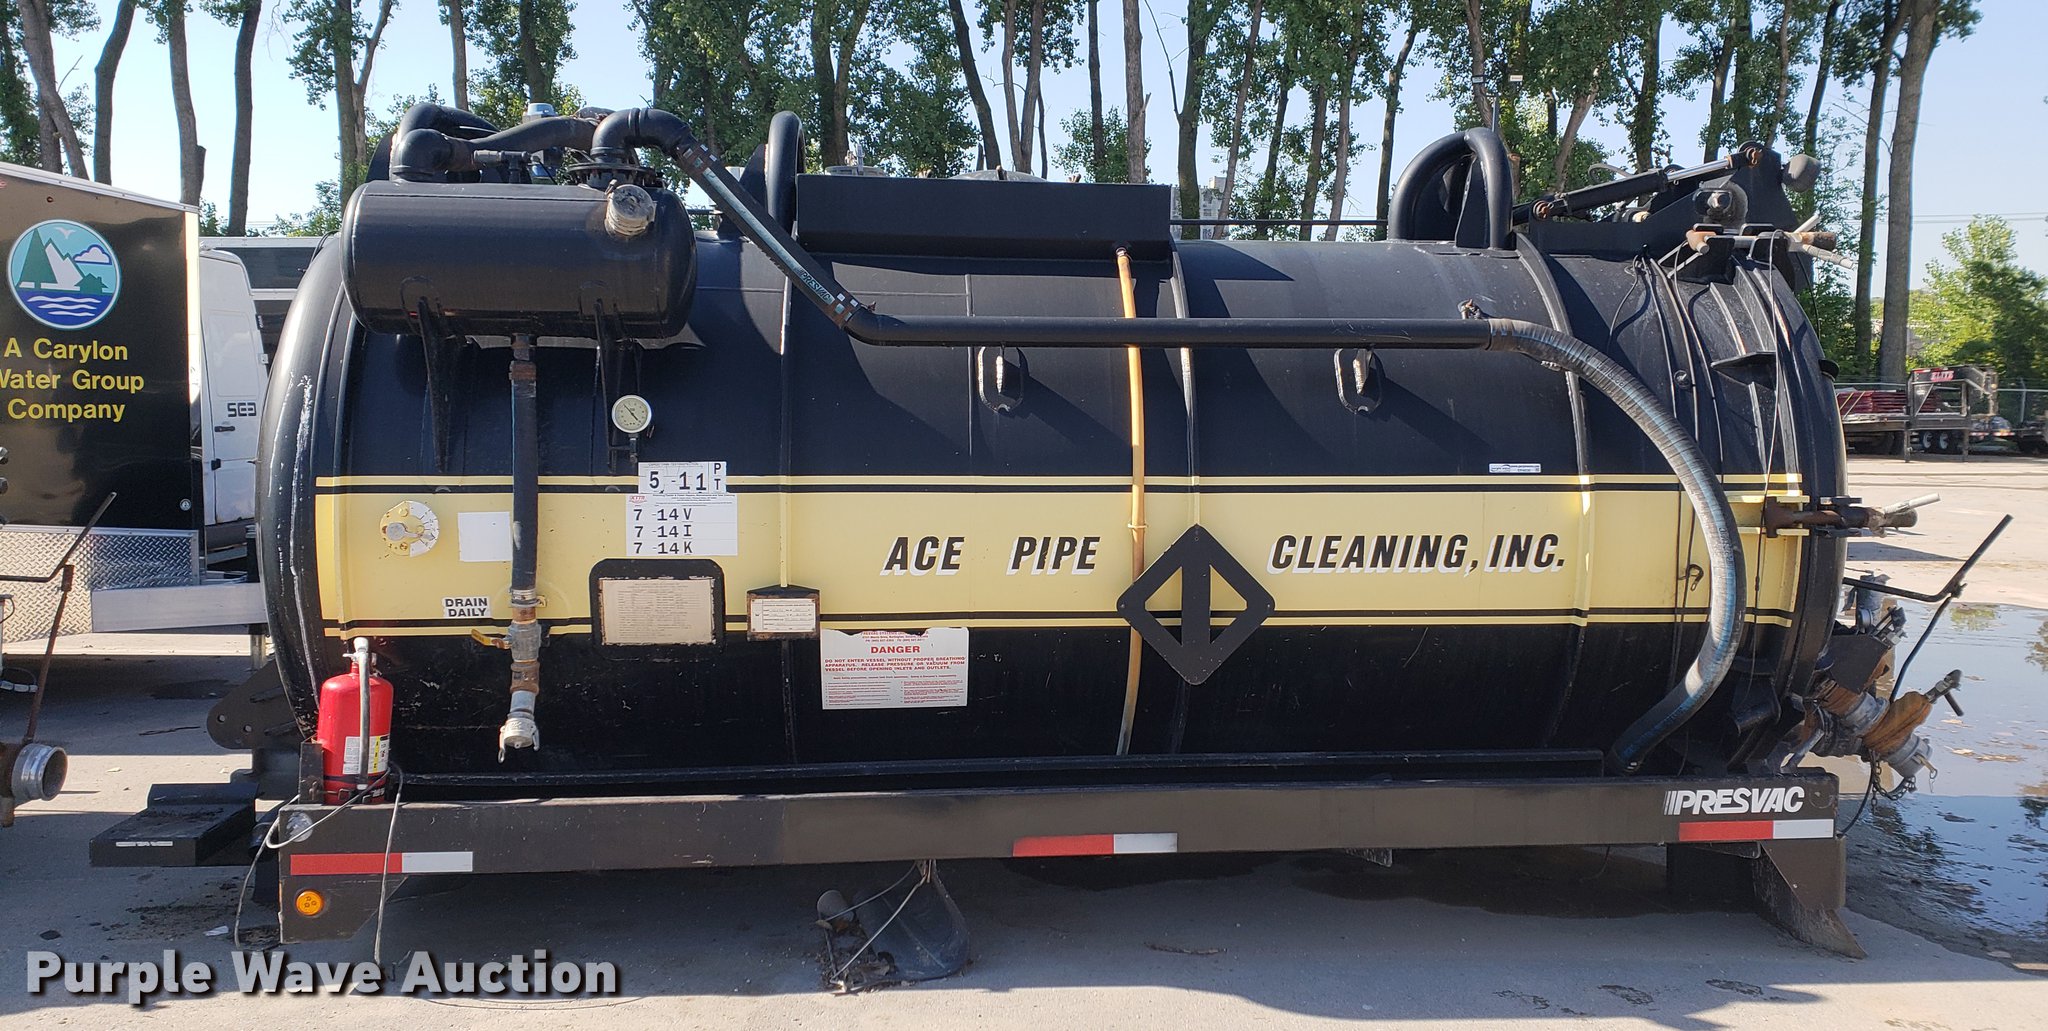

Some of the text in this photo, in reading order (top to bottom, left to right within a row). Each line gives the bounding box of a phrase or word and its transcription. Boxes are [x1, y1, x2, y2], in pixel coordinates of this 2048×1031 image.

[4, 337, 128, 364] A Carylon
[72, 369, 144, 394] Group
[7, 398, 126, 423] Company
[713, 462, 722, 475] P
[714, 478, 721, 490] T
[880, 535, 965, 576] ACE
[1006, 536, 1100, 576] PIPE
[445, 597, 488, 608] DRAIN
[448, 608, 487, 618] DAILY
[870, 645, 921, 654] DANGER
[1673, 786, 1805, 816] PRESVAC
